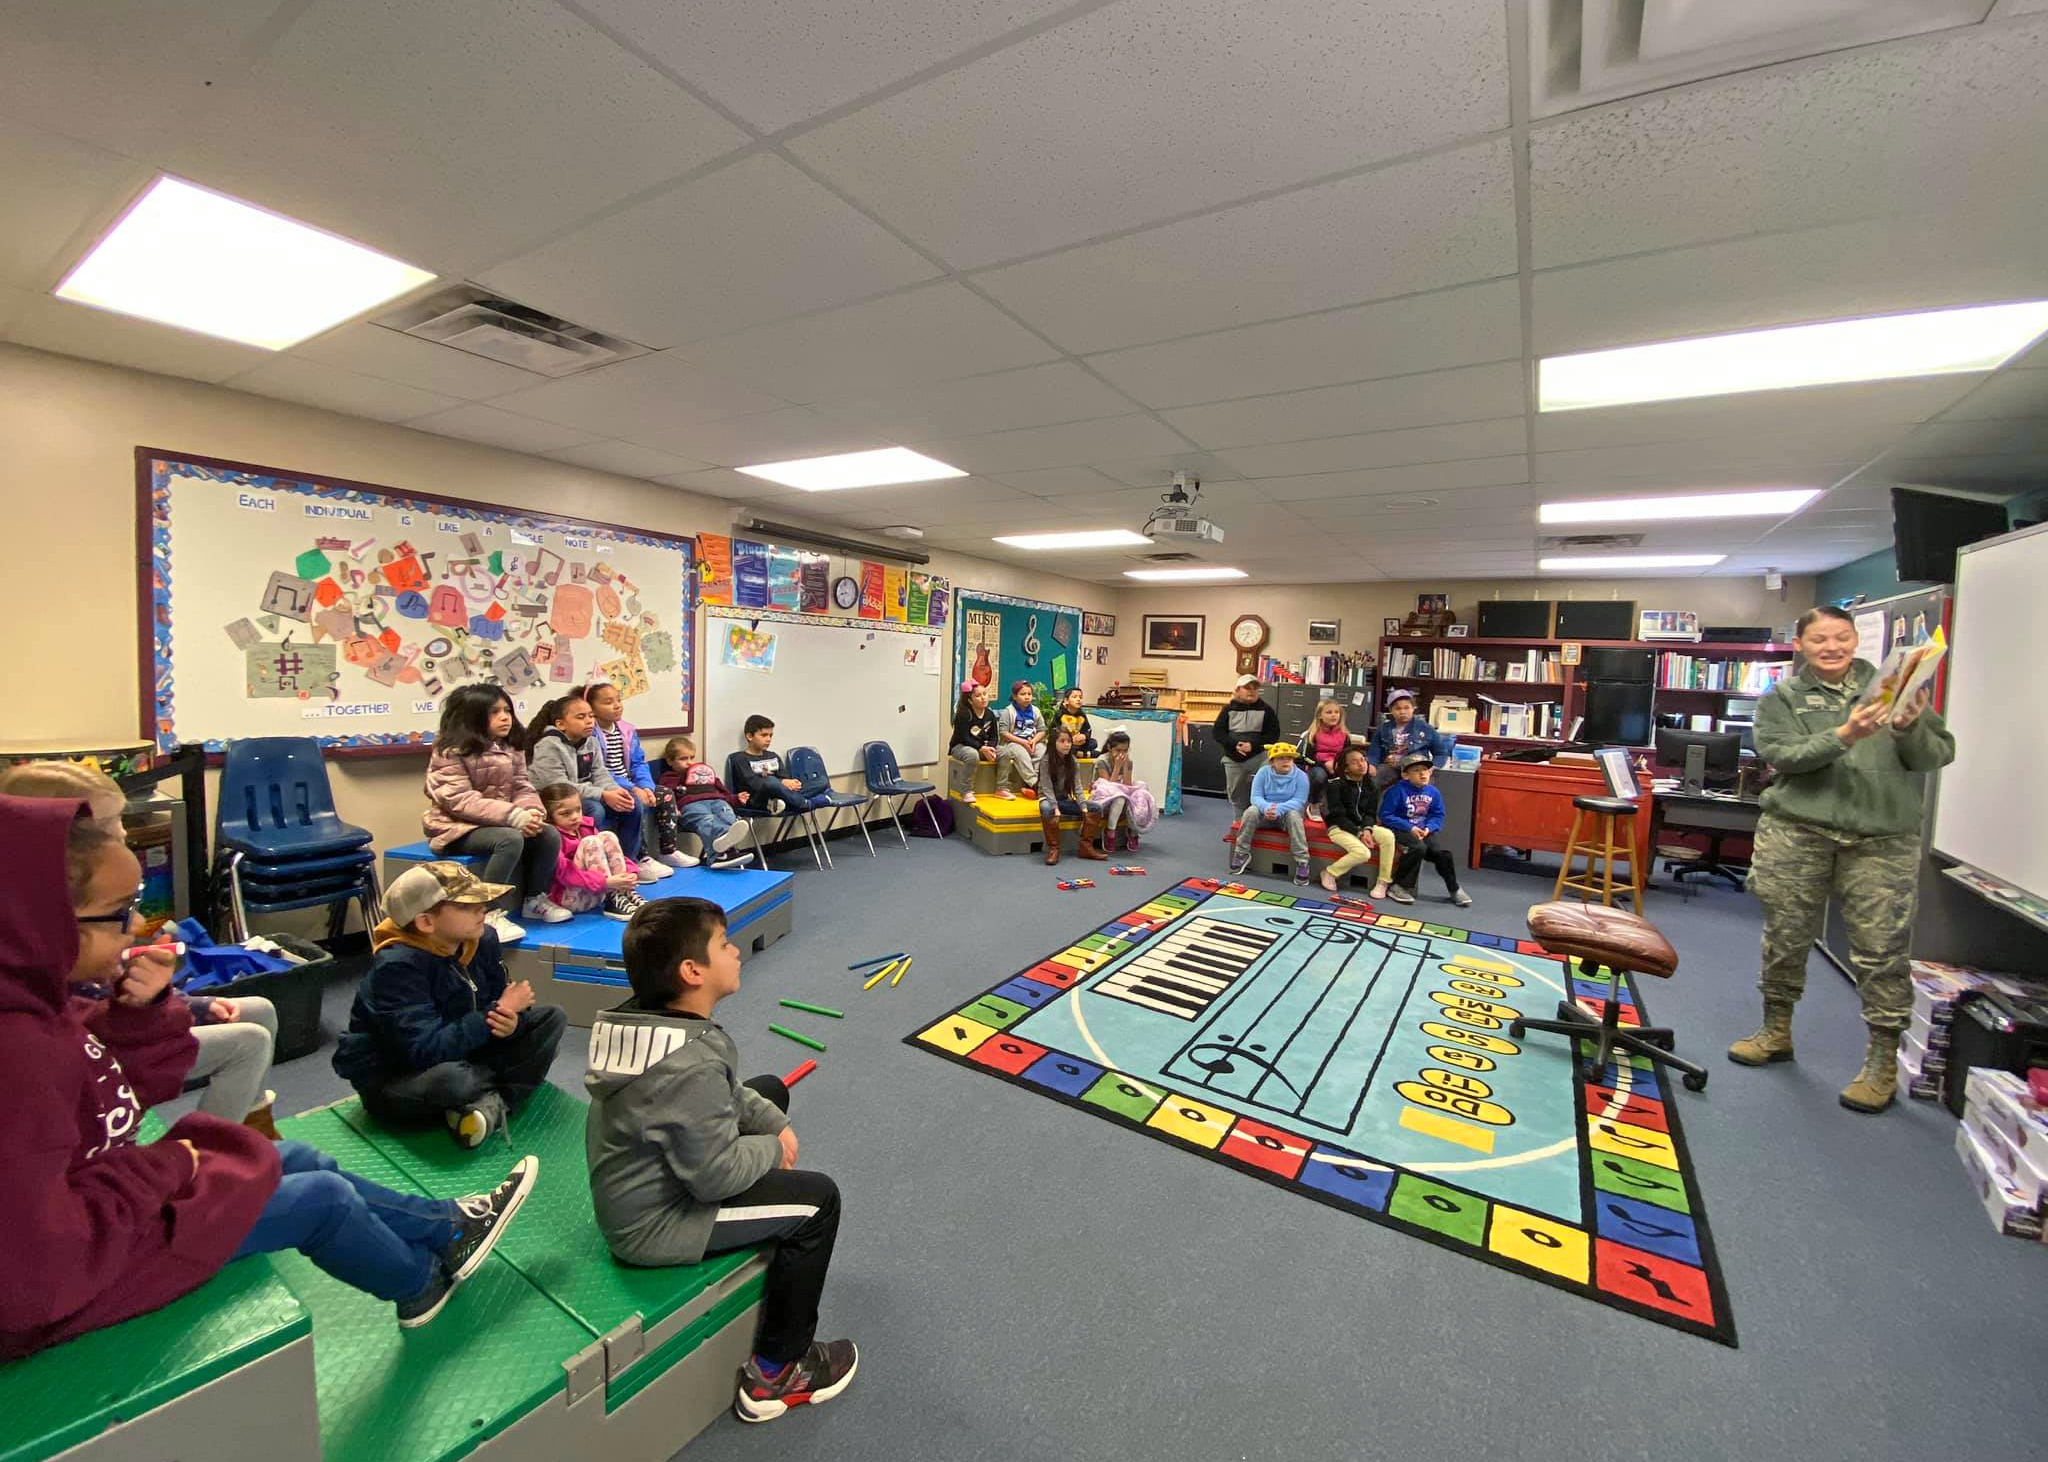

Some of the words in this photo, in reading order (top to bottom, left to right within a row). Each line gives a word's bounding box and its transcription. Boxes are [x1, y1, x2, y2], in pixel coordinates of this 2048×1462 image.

[239, 494, 275, 510] EACH
[305, 505, 370, 519] INDIVIDUAL
[401, 516, 411, 525] IS
[439, 523, 459, 533] LIKE
[486, 527, 493, 535] A
[565, 539, 589, 549] NOTE
[967, 612, 1000, 627] MUSIC
[326, 703, 390, 716] TOGETHER
[415, 702, 434, 711] WE
[518, 701, 525, 710] A
[1459, 968, 1499, 982] Do
[1459, 982, 1496, 996] Re
[1458, 998, 1492, 1013] Mi
[1455, 1010, 1491, 1026] Fa
[1445, 1029, 1490, 1047] So
[1443, 1050, 1483, 1068] La
[1442, 1073, 1480, 1094] Ti
[1424, 1090, 1480, 1116] Do
